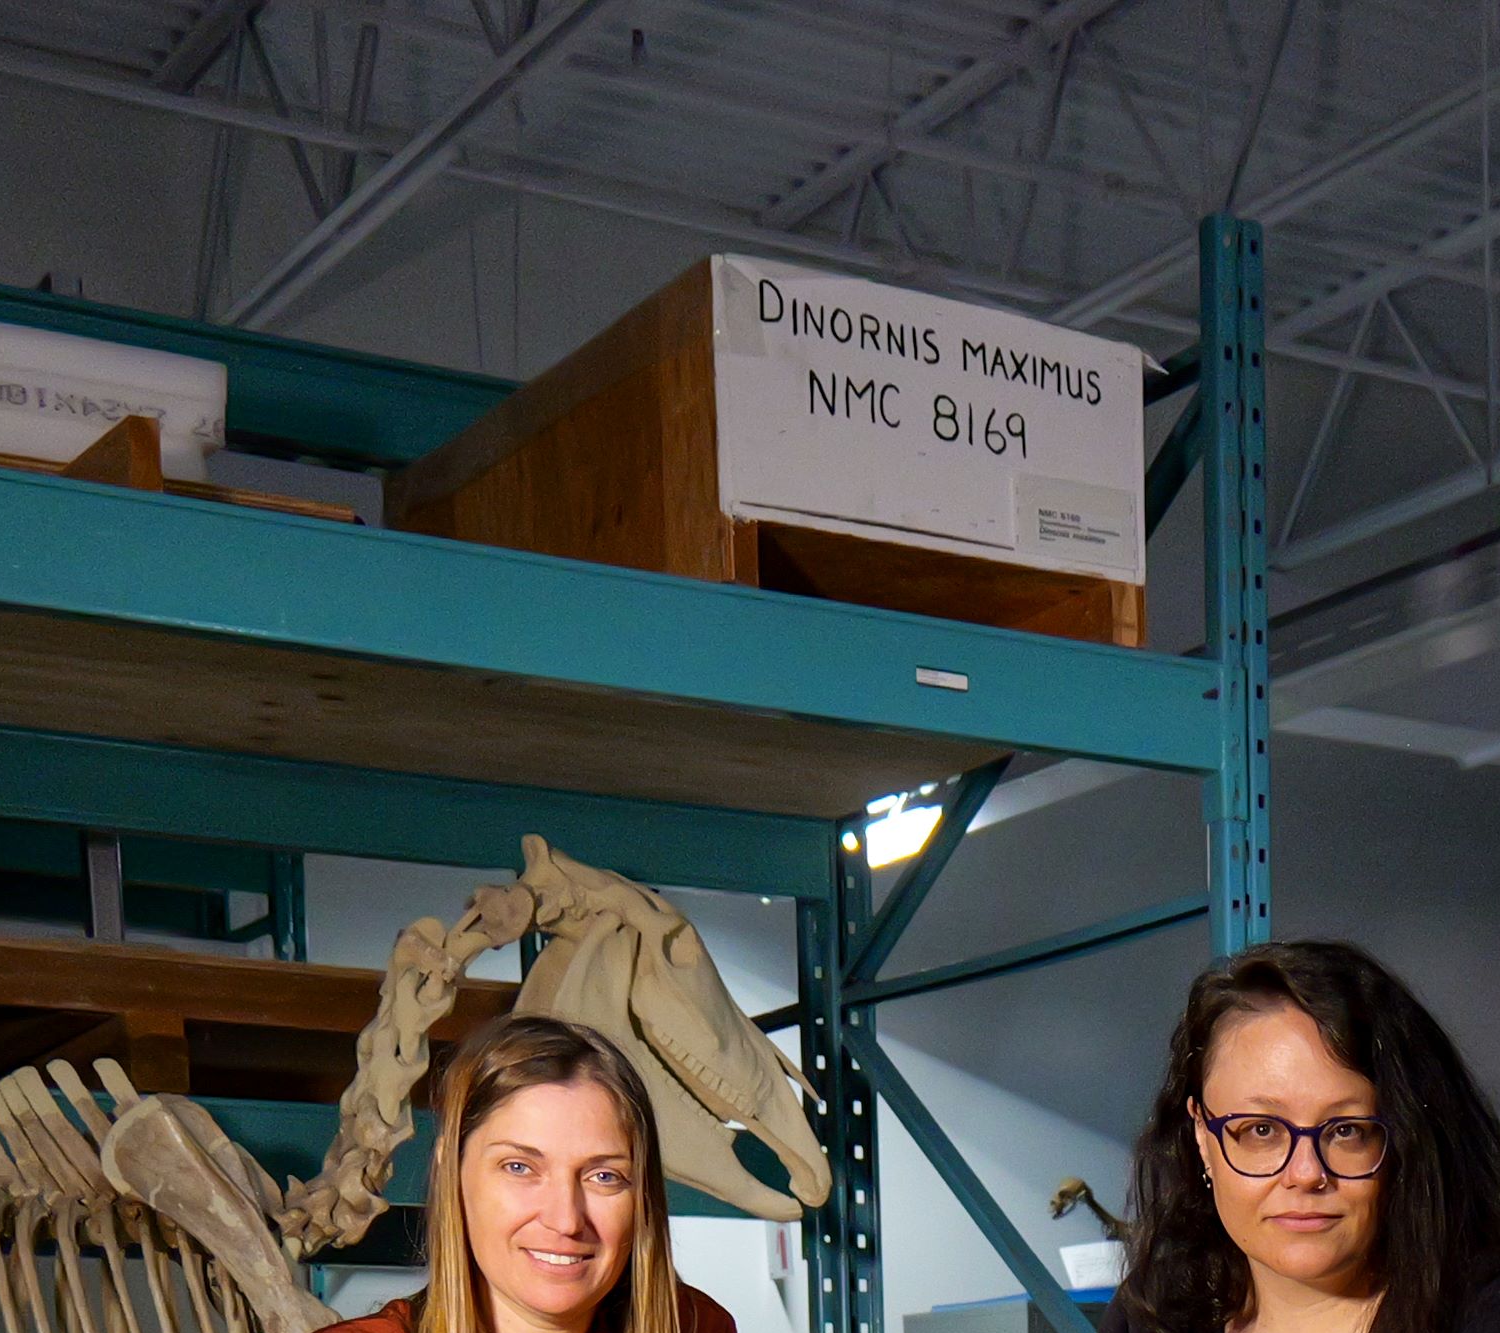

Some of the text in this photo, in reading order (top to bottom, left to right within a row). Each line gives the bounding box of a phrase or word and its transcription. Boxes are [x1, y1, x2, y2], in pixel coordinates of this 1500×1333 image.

[758, 278, 1102, 406] DINORNIS MAXIMUS
[808, 370, 1028, 459] NMC 8169
